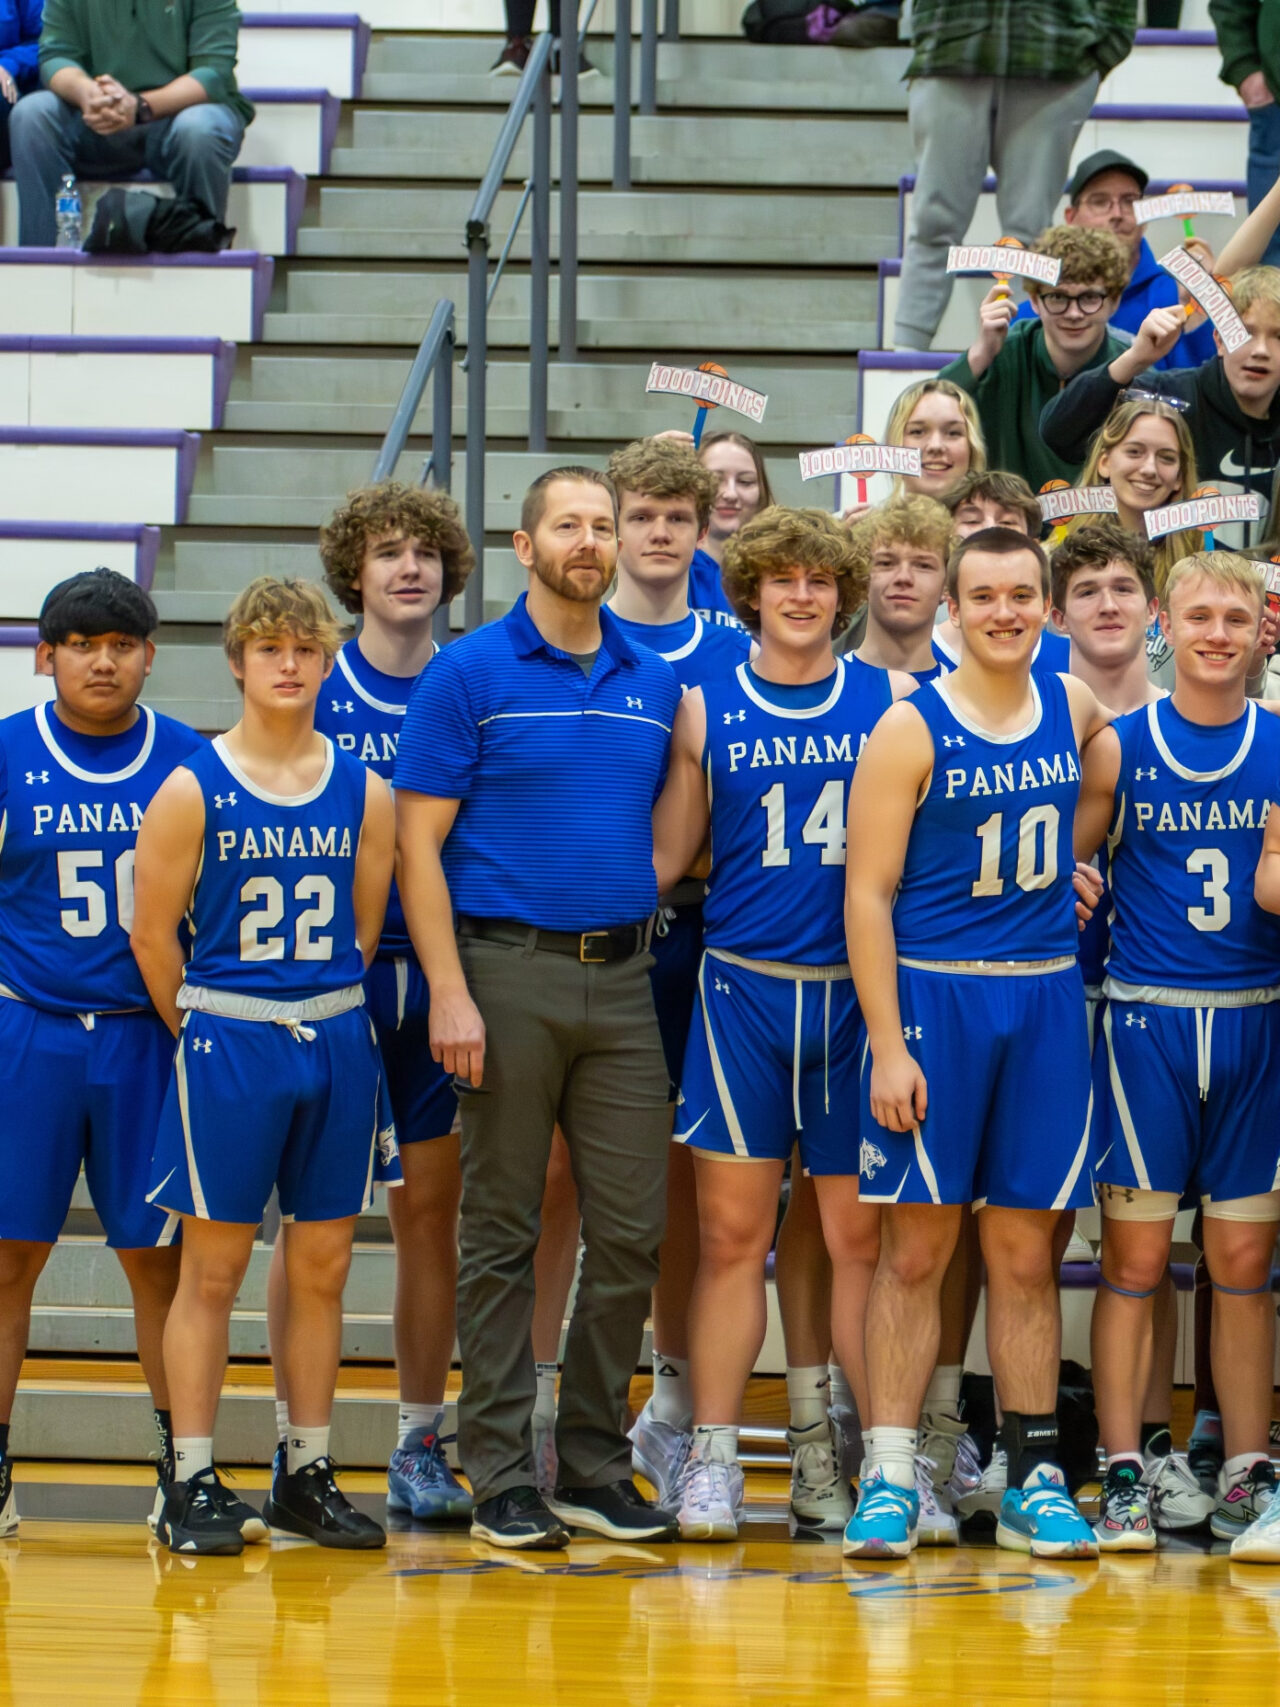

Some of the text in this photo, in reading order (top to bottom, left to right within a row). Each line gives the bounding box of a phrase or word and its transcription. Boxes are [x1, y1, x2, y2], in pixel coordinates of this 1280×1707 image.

[1137, 193, 1234, 221] 1000 POINTS
[950, 247, 1058, 284] 1000 POINTS
[1163, 249, 1247, 350] 1000 POINTS
[649, 366, 765, 420] 1000 POINTS
[803, 446, 920, 478] 1000 POINTS
[1049, 488, 1116, 515] POINTS
[1150, 496, 1258, 537] 1000 POINTS
[945, 751, 1080, 798] PANAMA
[217, 827, 352, 861] PANAMA
[760, 780, 846, 867] 14
[971, 804, 1060, 898] 10
[1186, 848, 1231, 932] 3
[239, 875, 335, 961] 22
